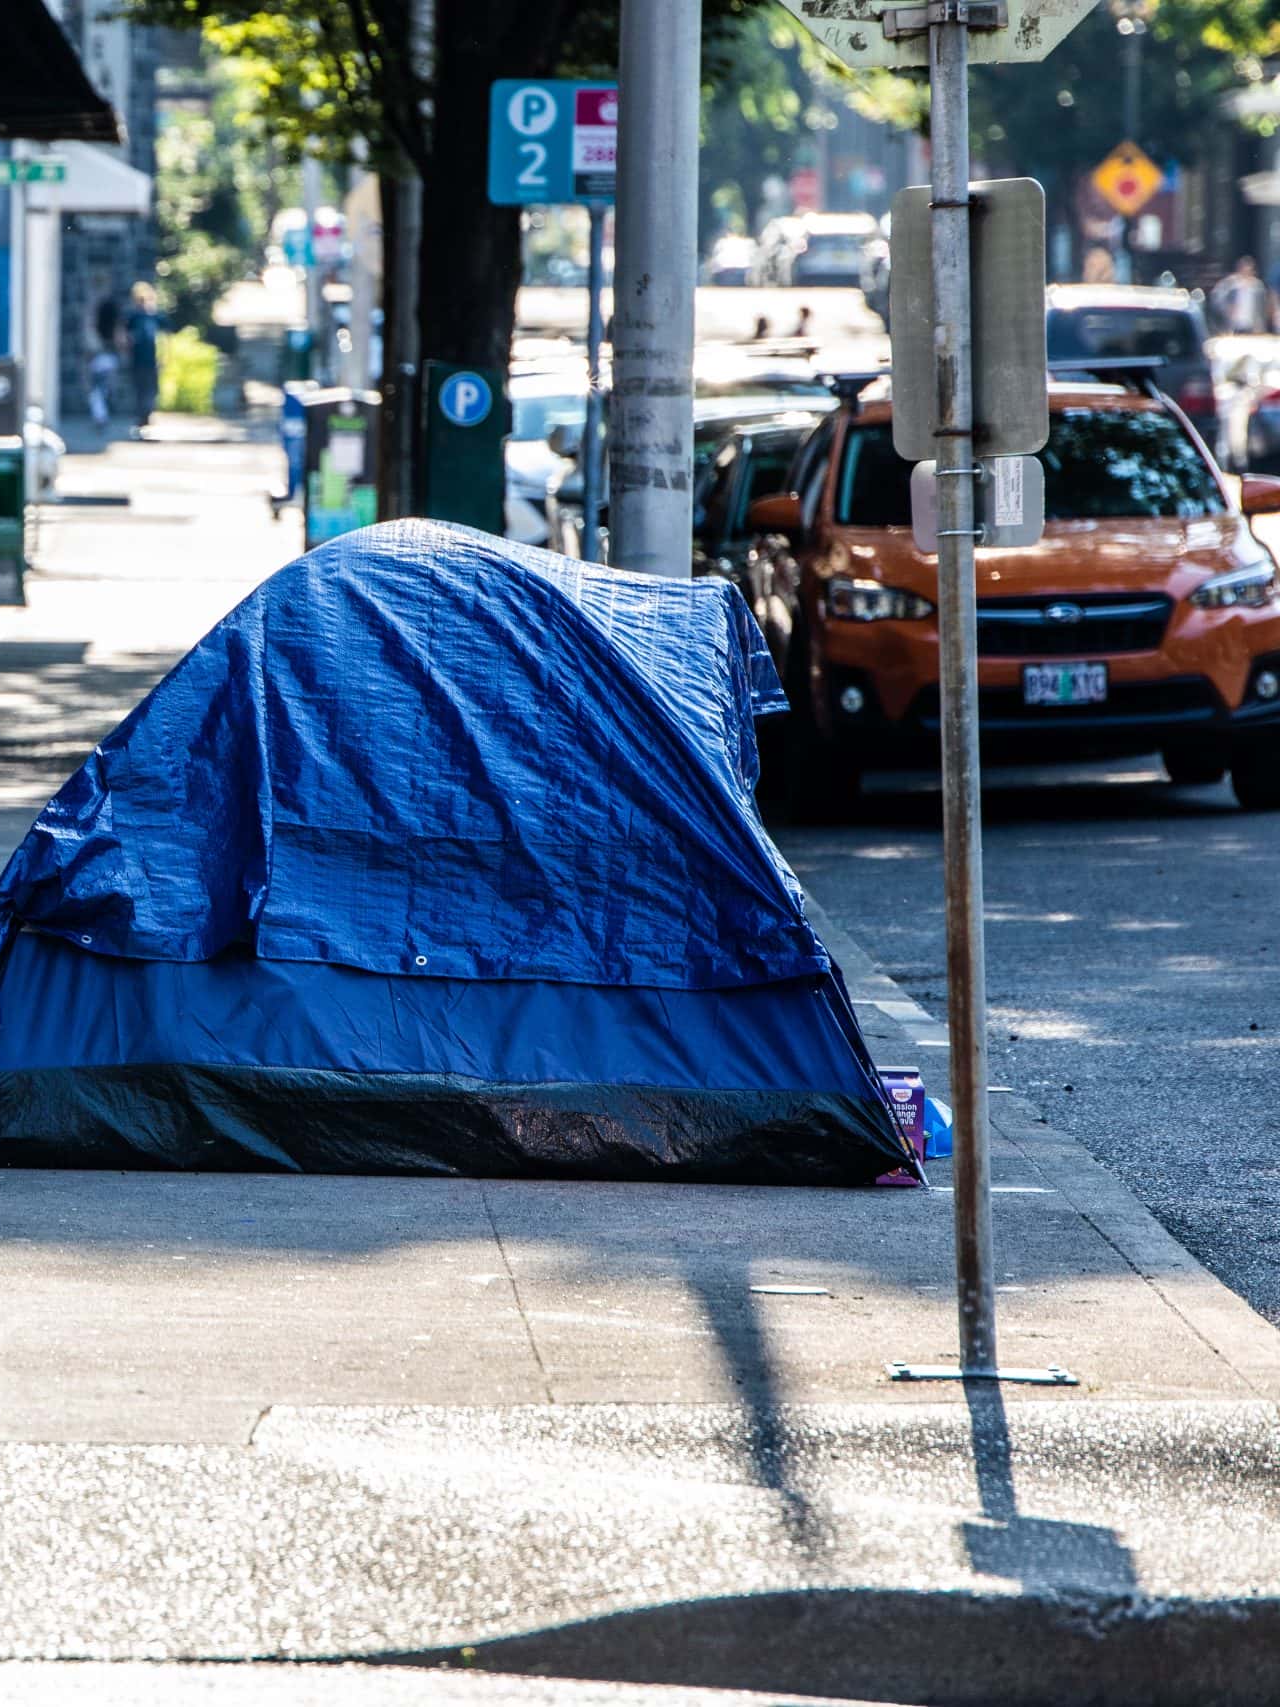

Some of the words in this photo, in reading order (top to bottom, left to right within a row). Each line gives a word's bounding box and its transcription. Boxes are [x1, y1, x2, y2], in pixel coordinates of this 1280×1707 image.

[523, 94, 548, 129] P
[518, 142, 547, 184] 2
[456, 381, 479, 418] P
